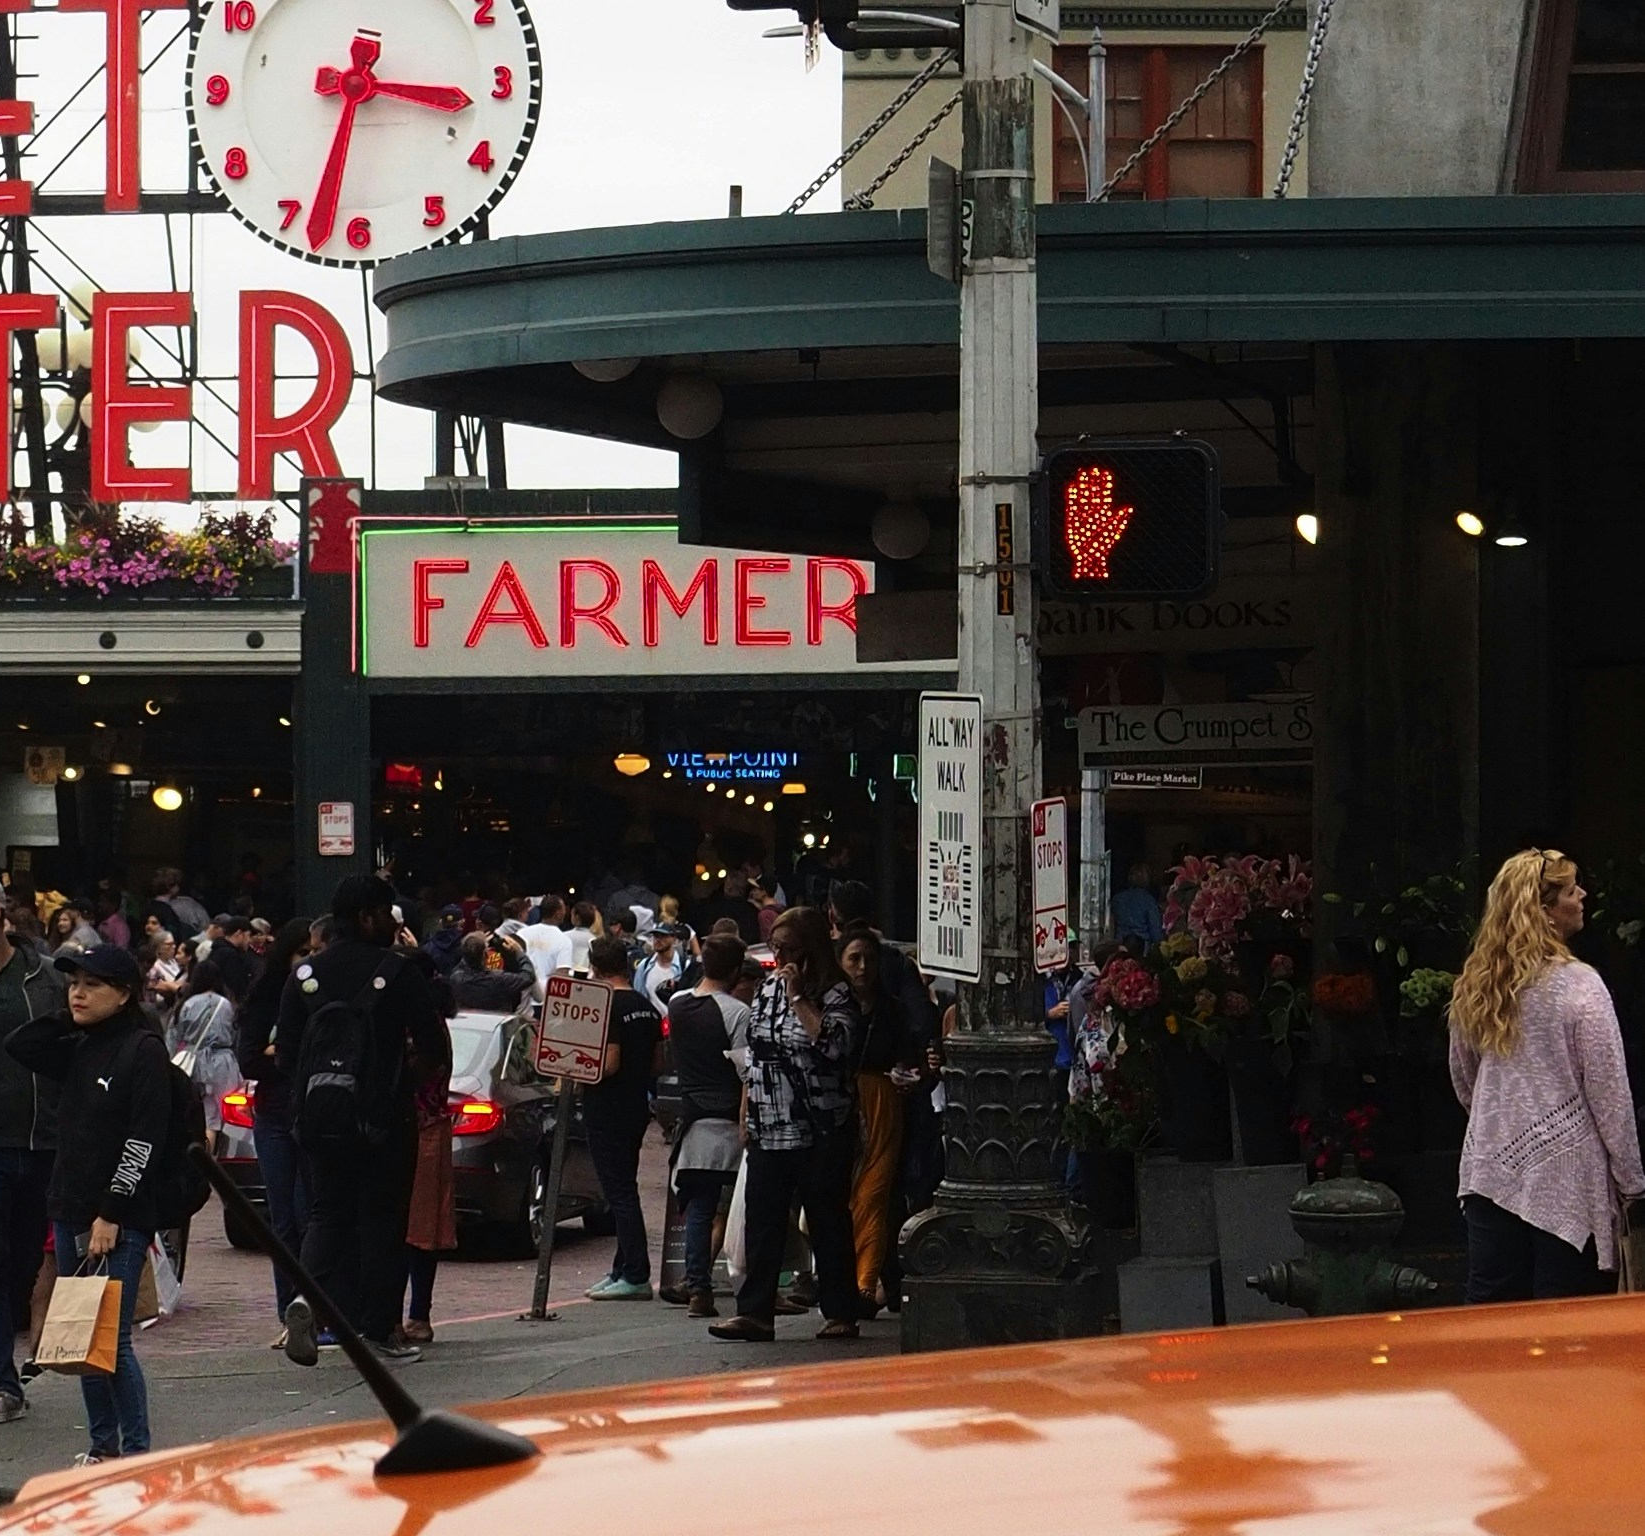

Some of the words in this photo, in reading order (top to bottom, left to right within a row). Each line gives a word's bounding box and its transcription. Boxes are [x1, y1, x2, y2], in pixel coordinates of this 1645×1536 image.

[224, 0, 256, 32] 10
[206, 75, 230, 106] 9
[491, 66, 513, 100] 3
[225, 147, 249, 180] 8
[468, 140, 495, 173] 4
[277, 200, 302, 231] 7
[423, 196, 445, 227] 5
[346, 217, 372, 249] 6
[928, 717, 949, 746] ALL
[952, 717, 975, 748] WAY
[1092, 711, 1146, 745] The
[1154, 707, 1278, 748] Crumpet
[686, 768, 693, 778] &
[696, 768, 732, 778] PUBLIC
[735, 768, 781, 778] SEATING
[937, 761, 966, 792] WALK
[1114, 771, 1135, 782] Pike
[1136, 772, 1162, 782] Place
[1163, 773, 1197, 783] Market
[324, 815, 349, 824] STOPS
[1035, 809, 1044, 833] NO
[1037, 840, 1063, 869] STOPS
[550, 980, 568, 995] NO
[551, 1001, 601, 1023] STOPS
[38, 1346, 52, 1360] Le
[55, 1345, 87, 1360] Panier
